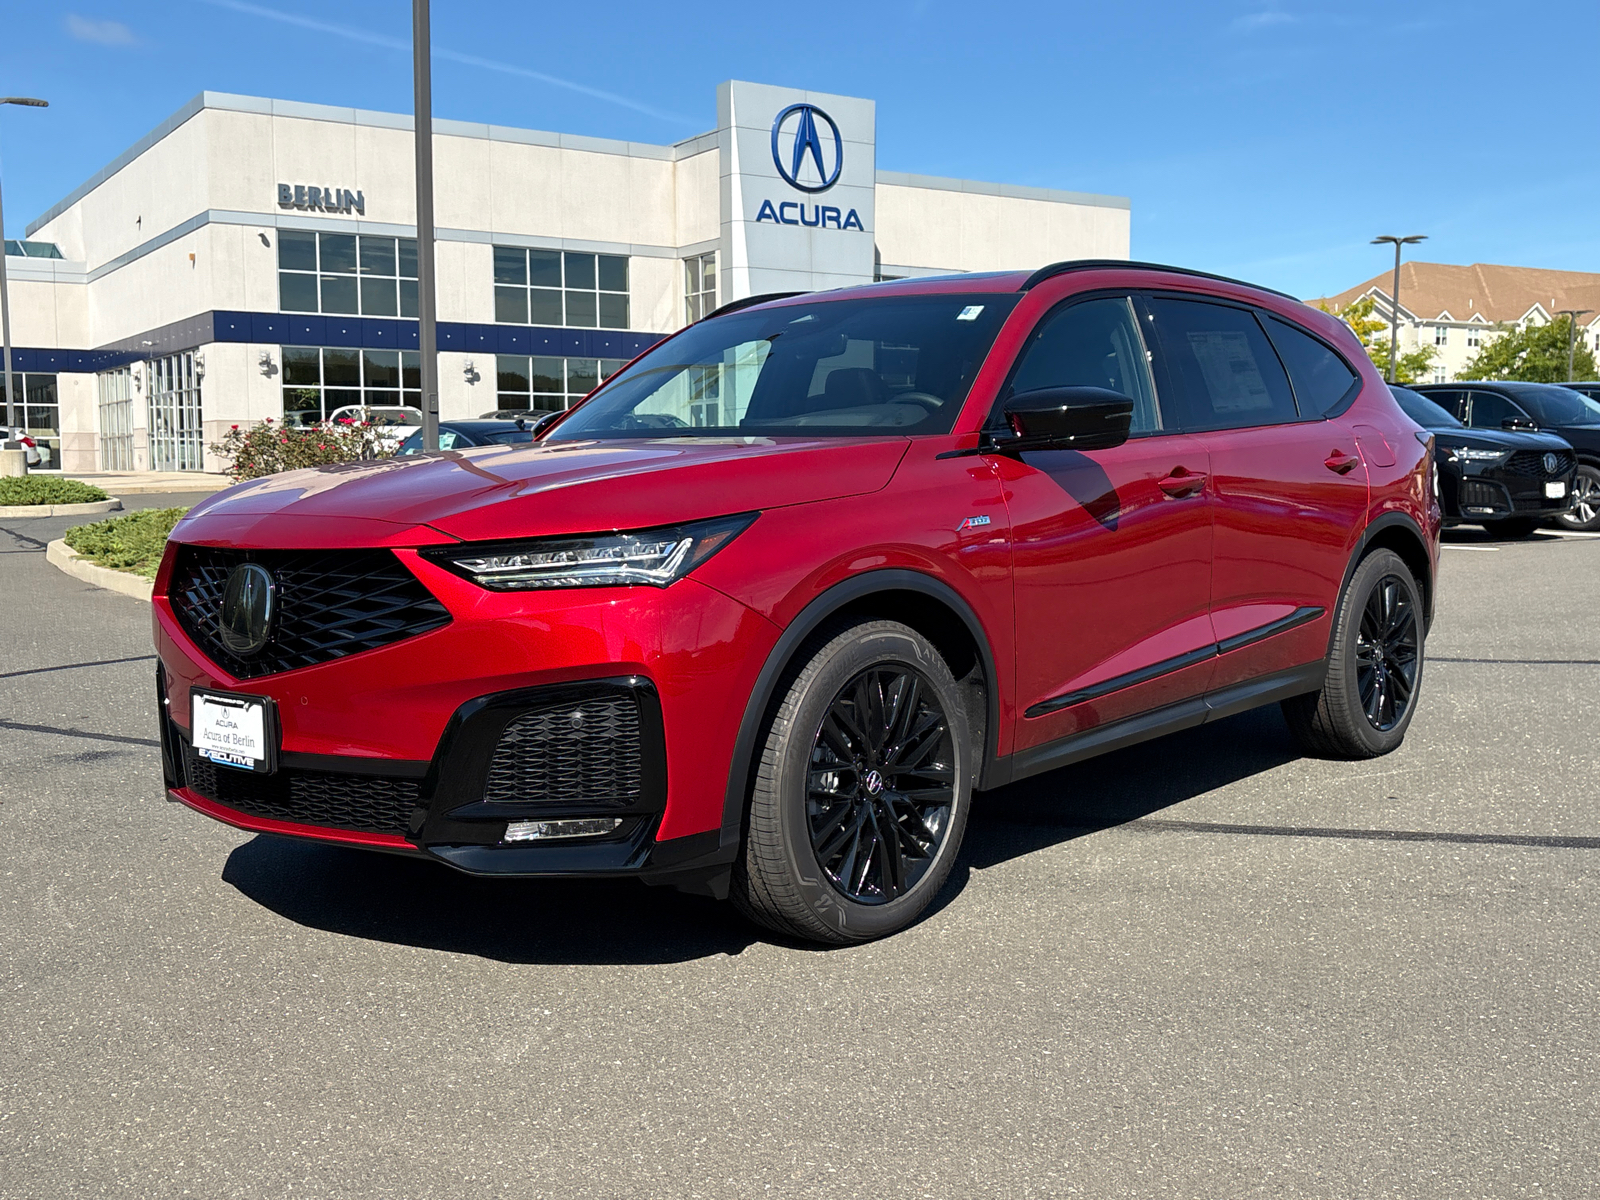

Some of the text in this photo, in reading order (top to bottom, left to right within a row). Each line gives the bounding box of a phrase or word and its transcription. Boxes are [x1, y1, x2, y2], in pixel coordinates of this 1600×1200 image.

[277, 183, 365, 216] BERLIN
[756, 199, 864, 231] ACURA
[215, 719, 238, 729] ACURA
[203, 728, 255, 748] Acura of Berlin
[198, 748, 255, 768] EXECUTIVE
